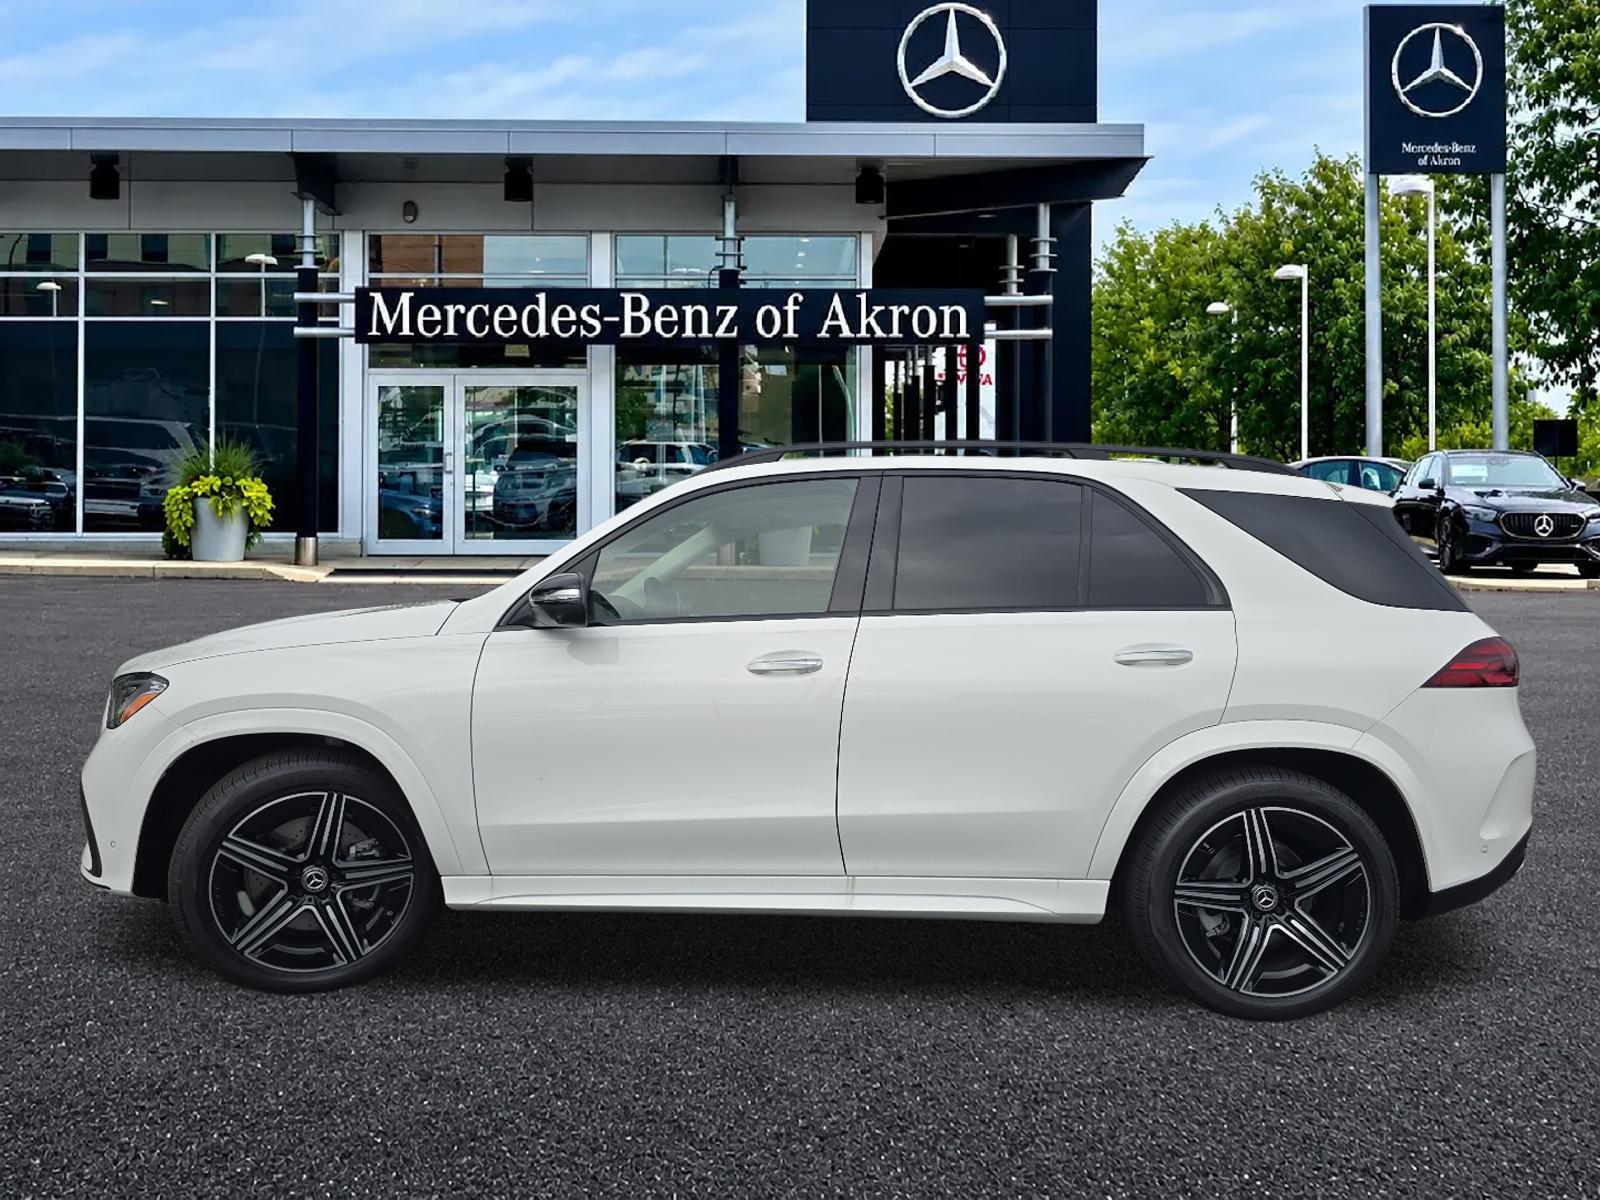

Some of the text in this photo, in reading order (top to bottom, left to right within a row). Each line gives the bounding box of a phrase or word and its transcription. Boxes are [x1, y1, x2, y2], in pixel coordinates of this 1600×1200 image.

[1401, 141, 1476, 154] Mercedes-Benz
[1417, 154, 1461, 166] of Akron
[367, 290, 971, 338] Mercedes-Benz of Akron
